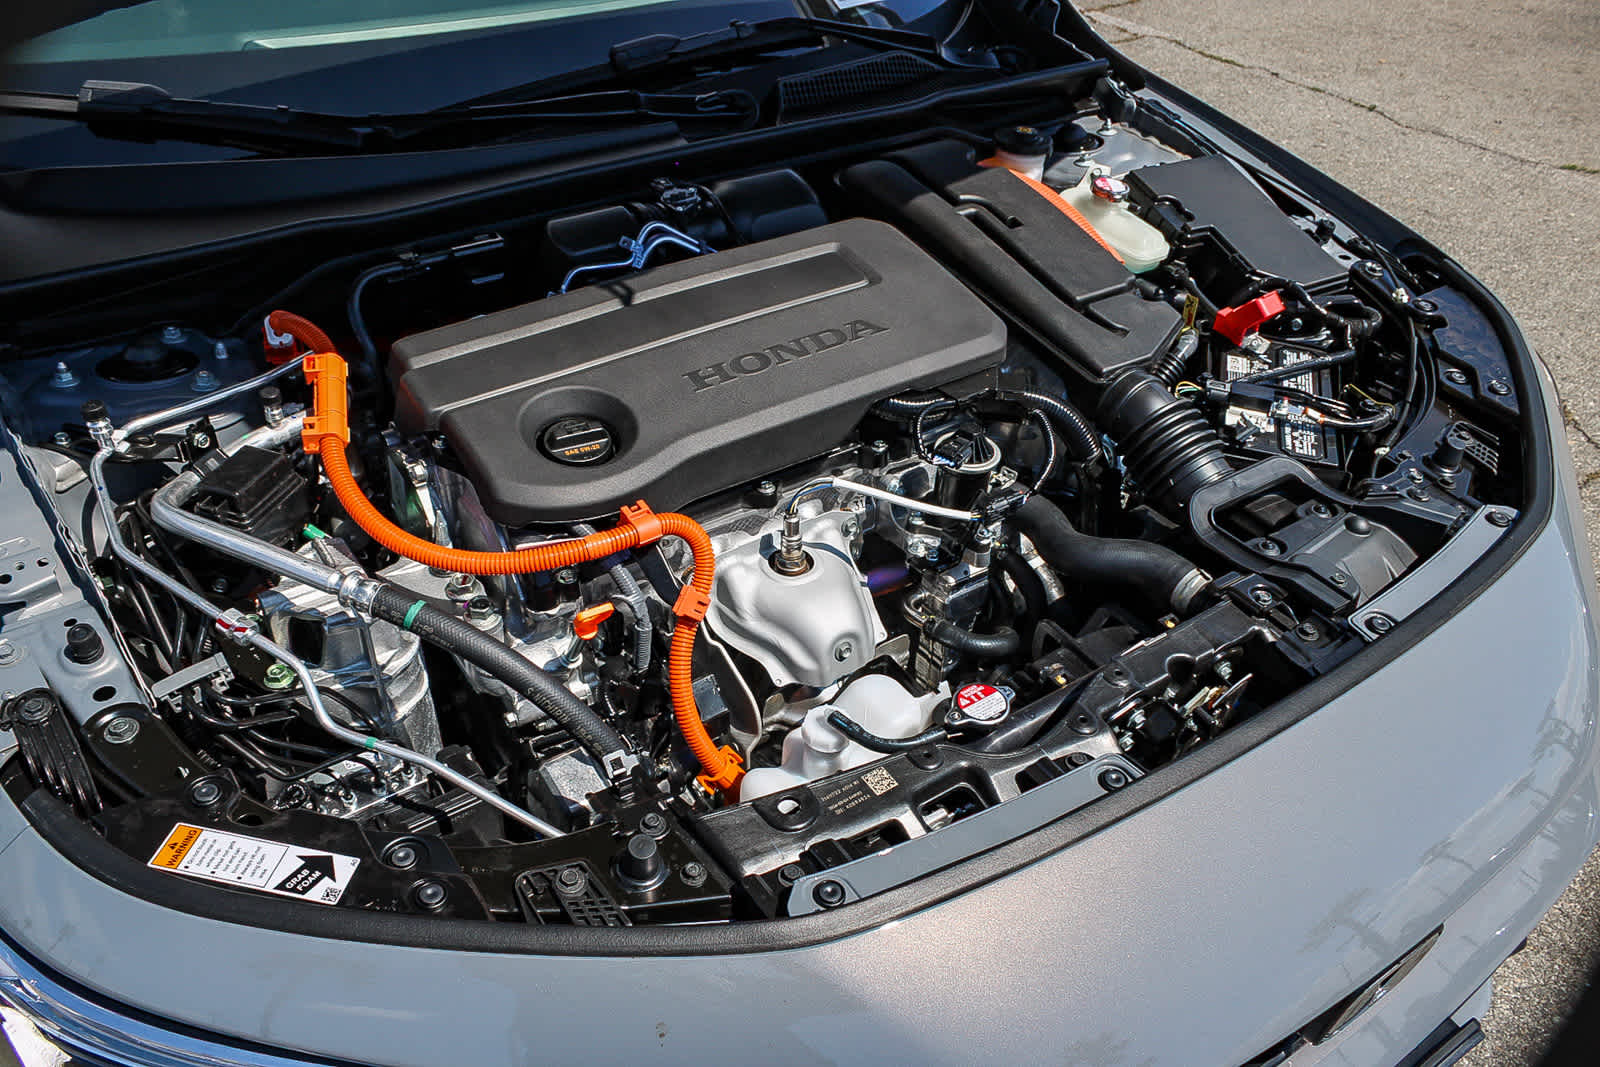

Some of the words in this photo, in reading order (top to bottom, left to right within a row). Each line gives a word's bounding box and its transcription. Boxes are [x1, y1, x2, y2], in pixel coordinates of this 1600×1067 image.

[681, 319, 890, 393] HONDA
[165, 830, 198, 866] WARNING
[285, 868, 310, 889] GRAB
[296, 870, 322, 891] FOAM
